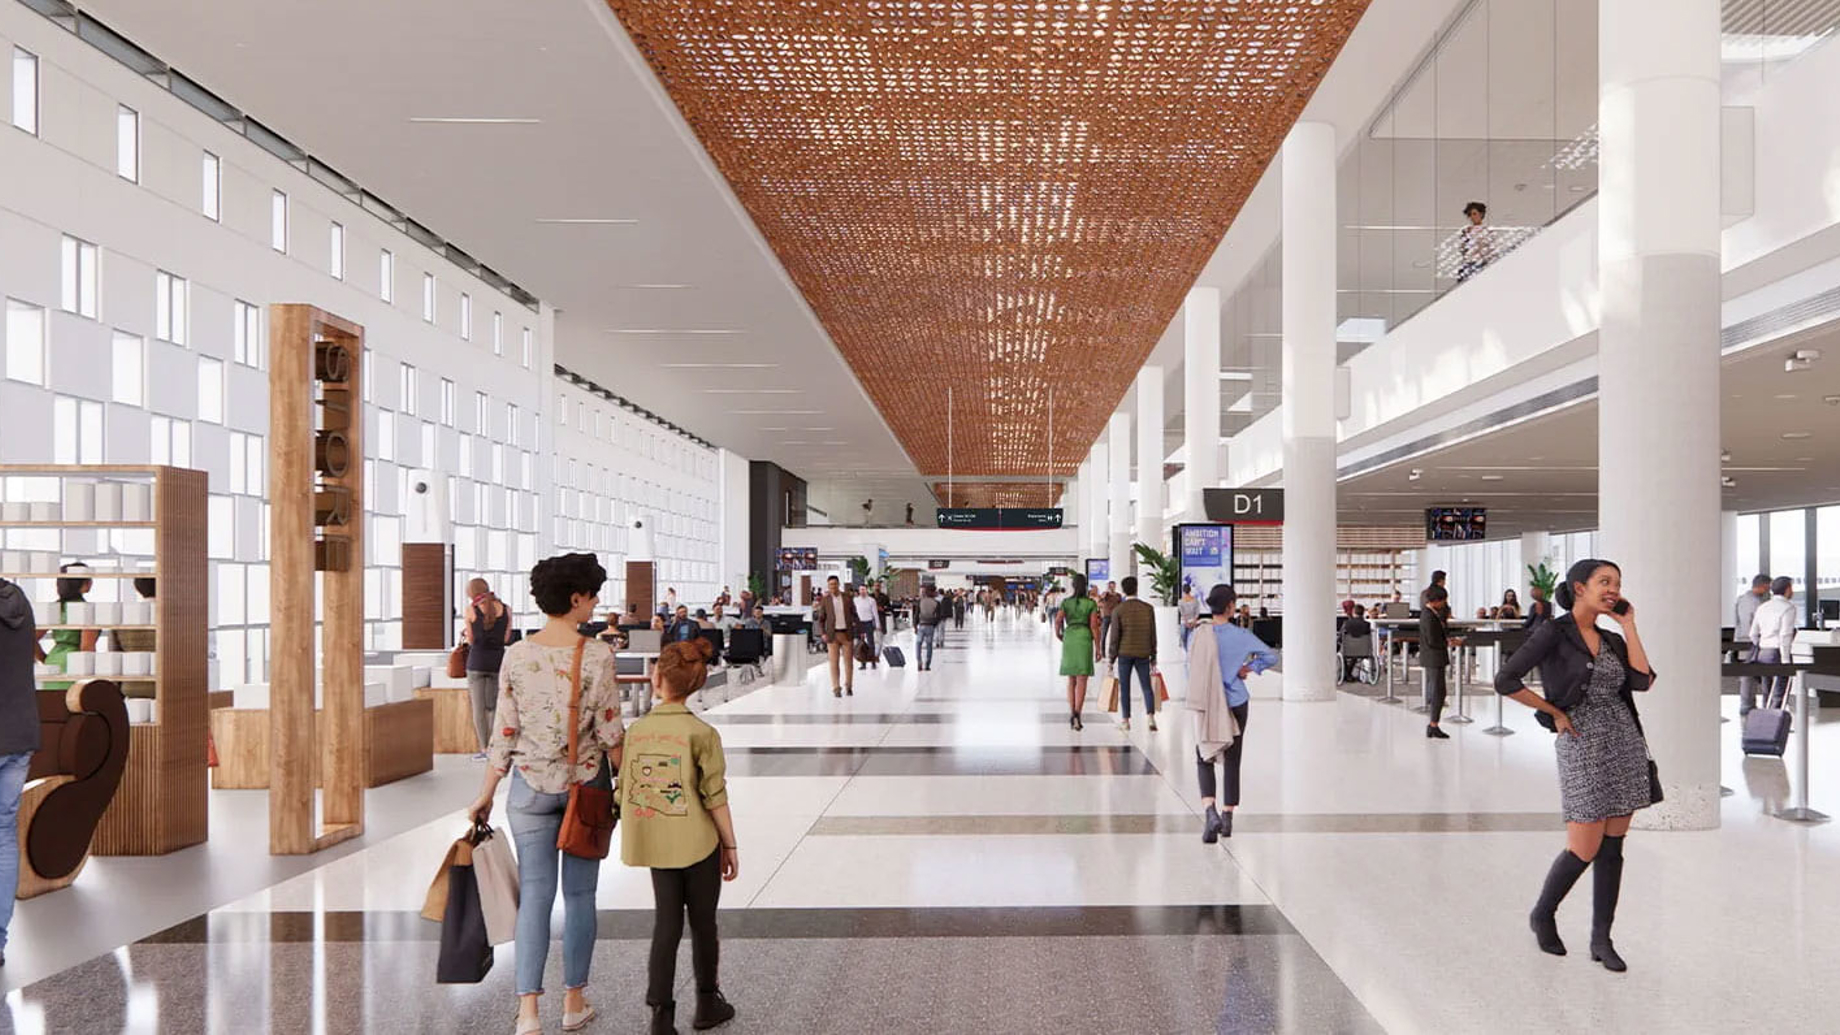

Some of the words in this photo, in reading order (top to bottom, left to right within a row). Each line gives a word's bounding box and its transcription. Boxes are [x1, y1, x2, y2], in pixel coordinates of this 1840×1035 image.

[1234, 494, 1262, 514] D1
[1185, 528, 1219, 538] AMBITION
[1185, 547, 1203, 556] WAIT
